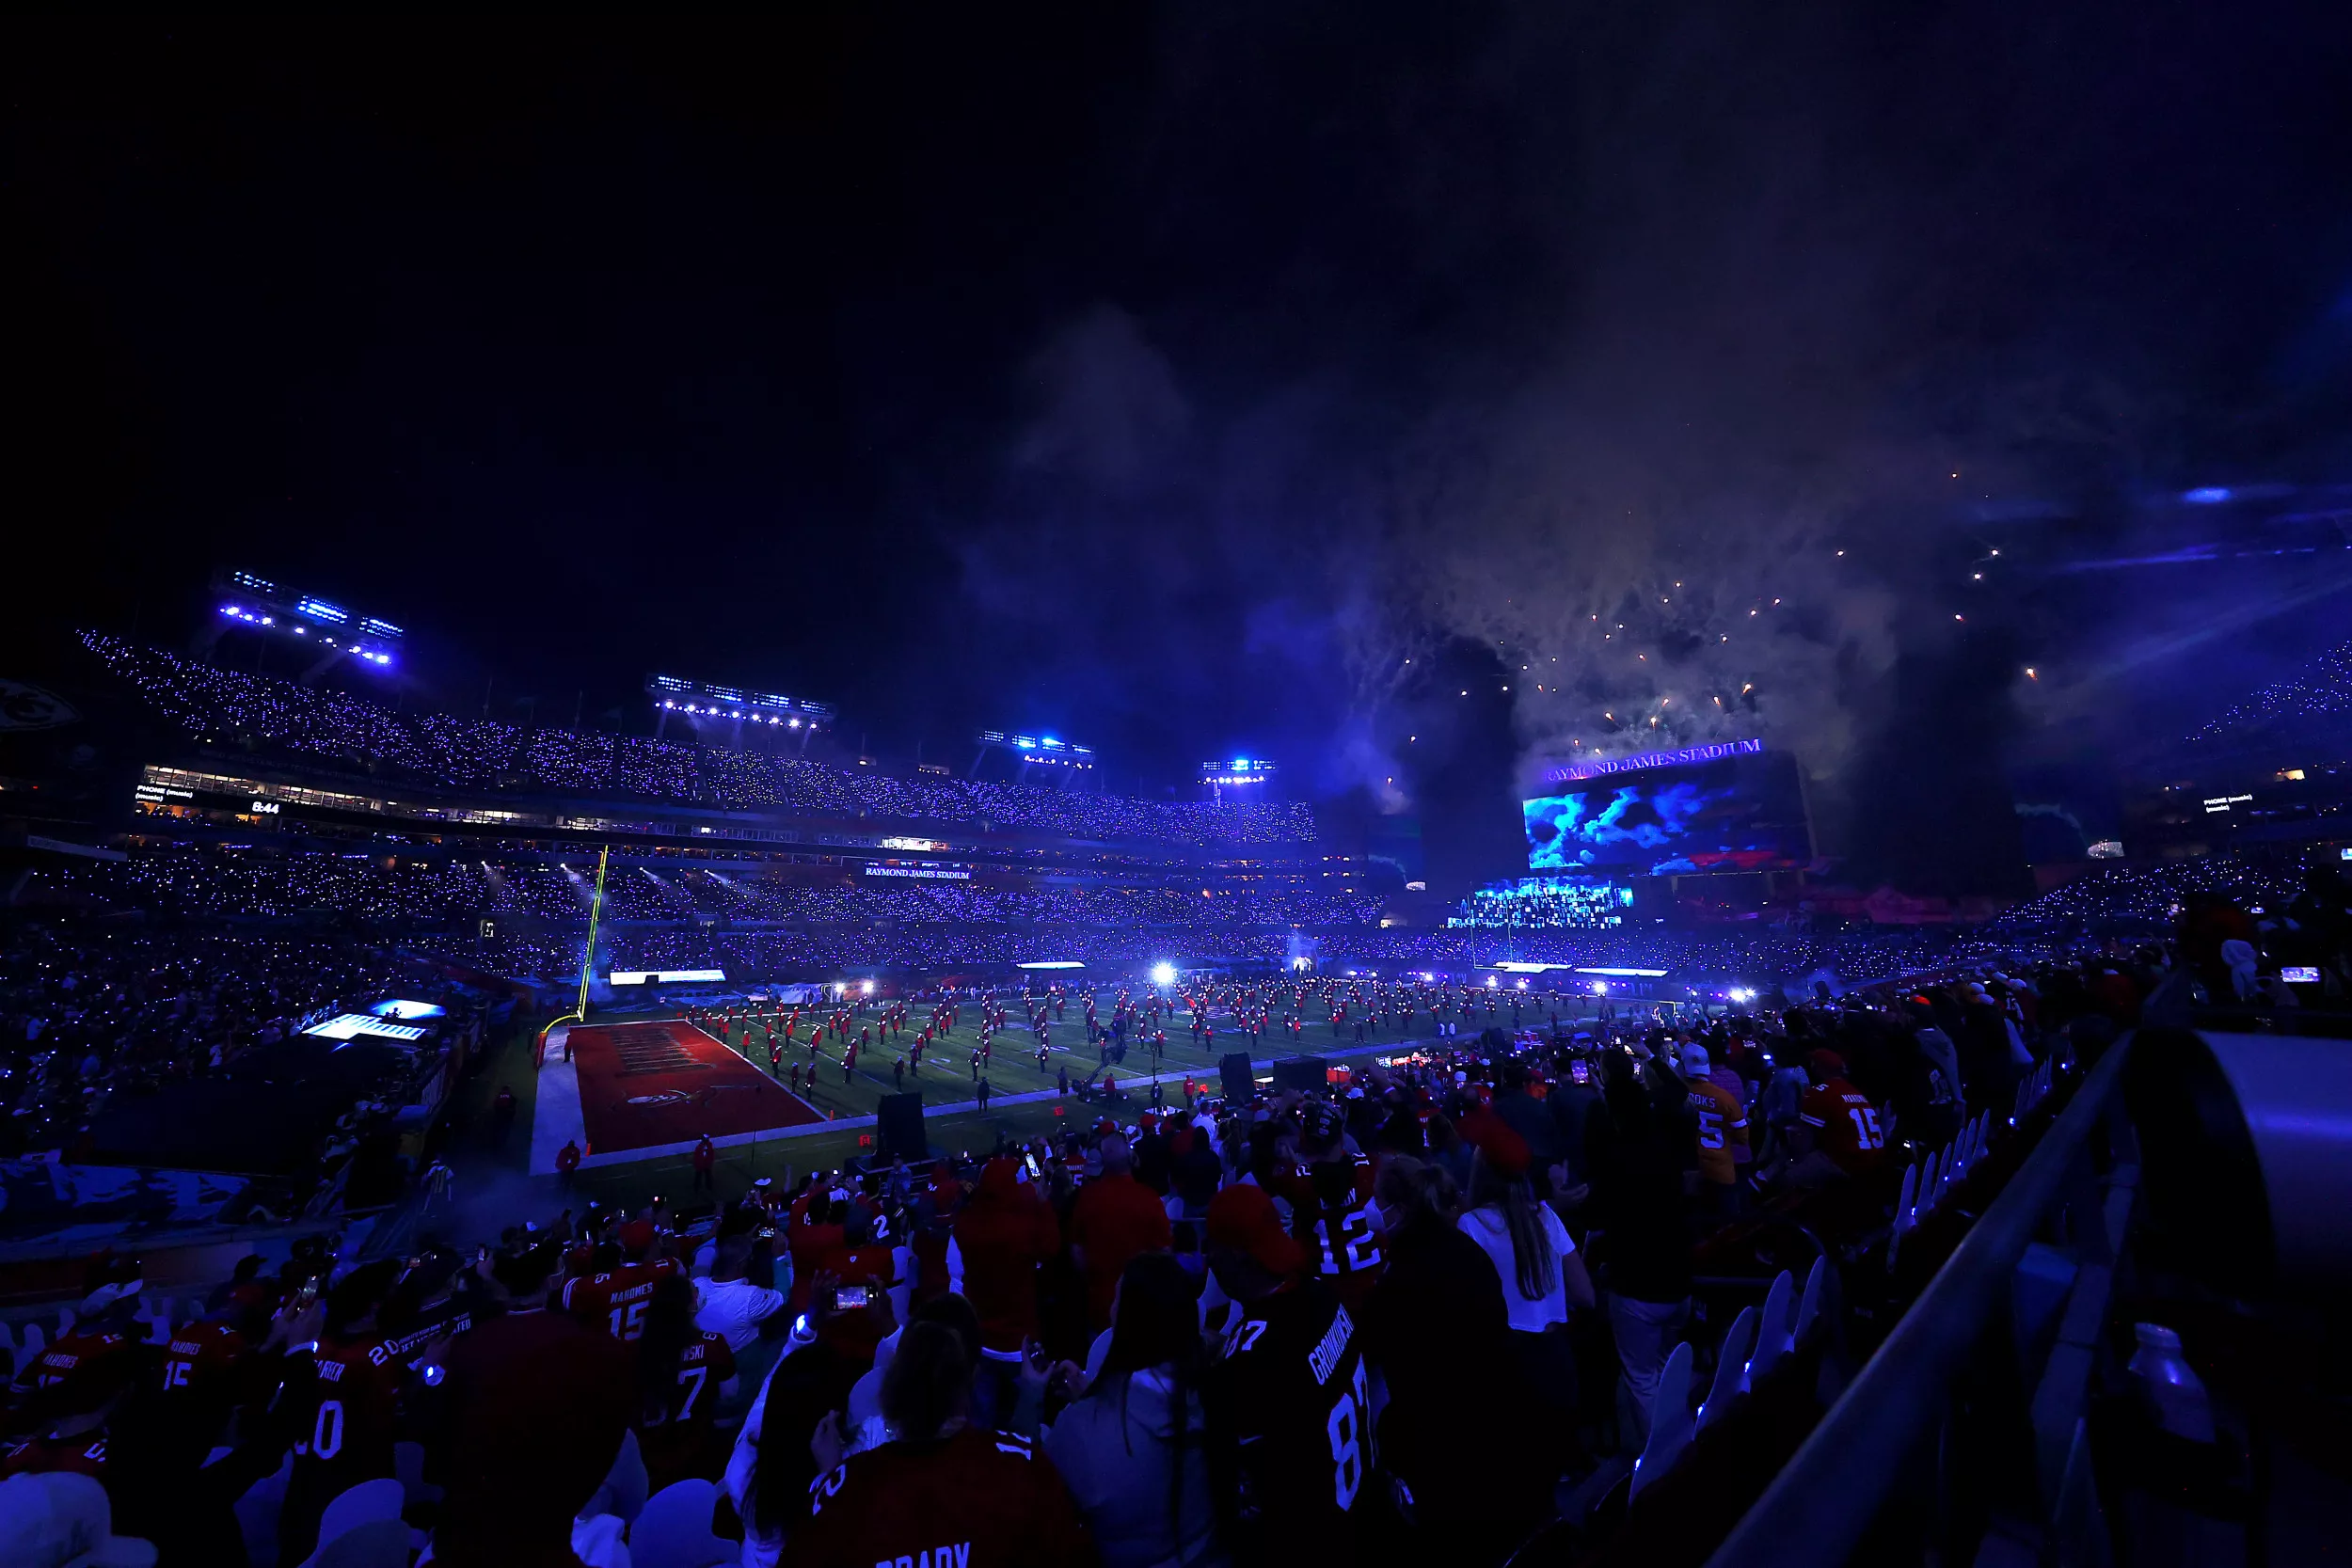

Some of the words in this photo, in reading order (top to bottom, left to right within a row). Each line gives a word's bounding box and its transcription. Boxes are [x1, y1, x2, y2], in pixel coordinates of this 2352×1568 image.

[1620, 753, 1676, 771] JAMES
[1678, 738, 1761, 762] STADIUM
[866, 867, 909, 877] RAYMOND
[909, 869, 936, 879] JAMES
[936, 871, 970, 880] STADIUM
[1849, 1107, 1885, 1150] 15
[1313, 1210, 1382, 1275] 12
[610, 1282, 654, 1305] MAHOMES
[608, 1299, 652, 1342] 15
[368, 1338, 400, 1368] 20
[1309, 1302, 1355, 1386] GRONKOWSKI
[163, 1360, 193, 1391] 15
[675, 1365, 707, 1423] 7
[876, 1542, 971, 1568] ADY
